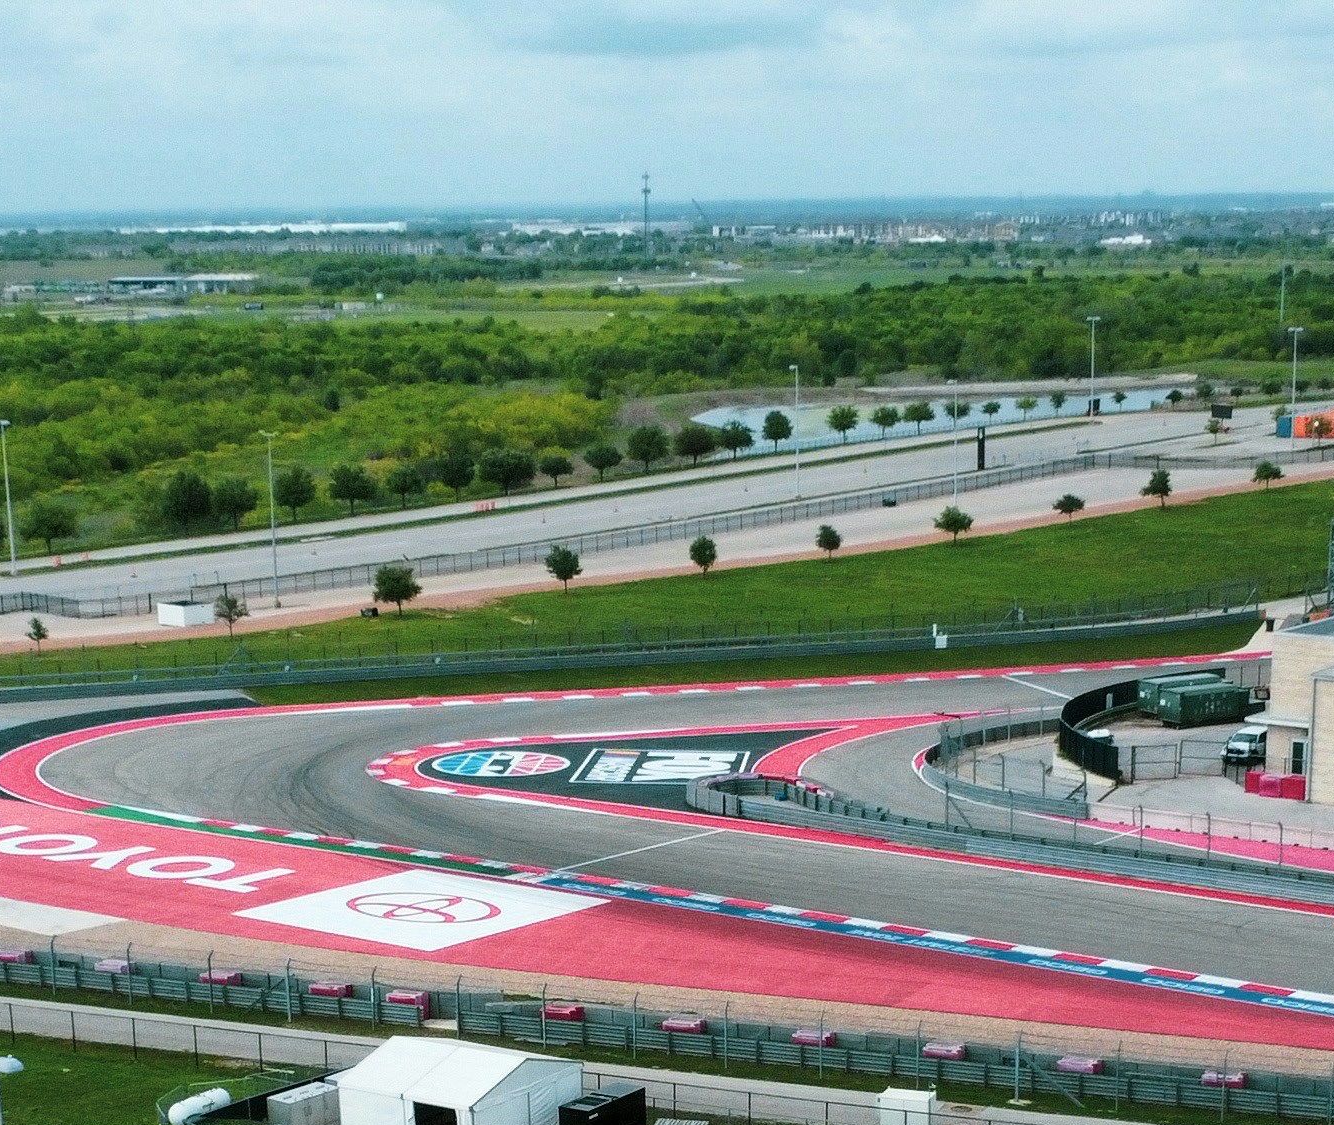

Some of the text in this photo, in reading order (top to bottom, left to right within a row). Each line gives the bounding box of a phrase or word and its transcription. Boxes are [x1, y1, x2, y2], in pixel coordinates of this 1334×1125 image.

[746, 912, 817, 927] GEICO
[1027, 959, 1108, 975] GEICO
[1141, 977, 1226, 995] GEICO
